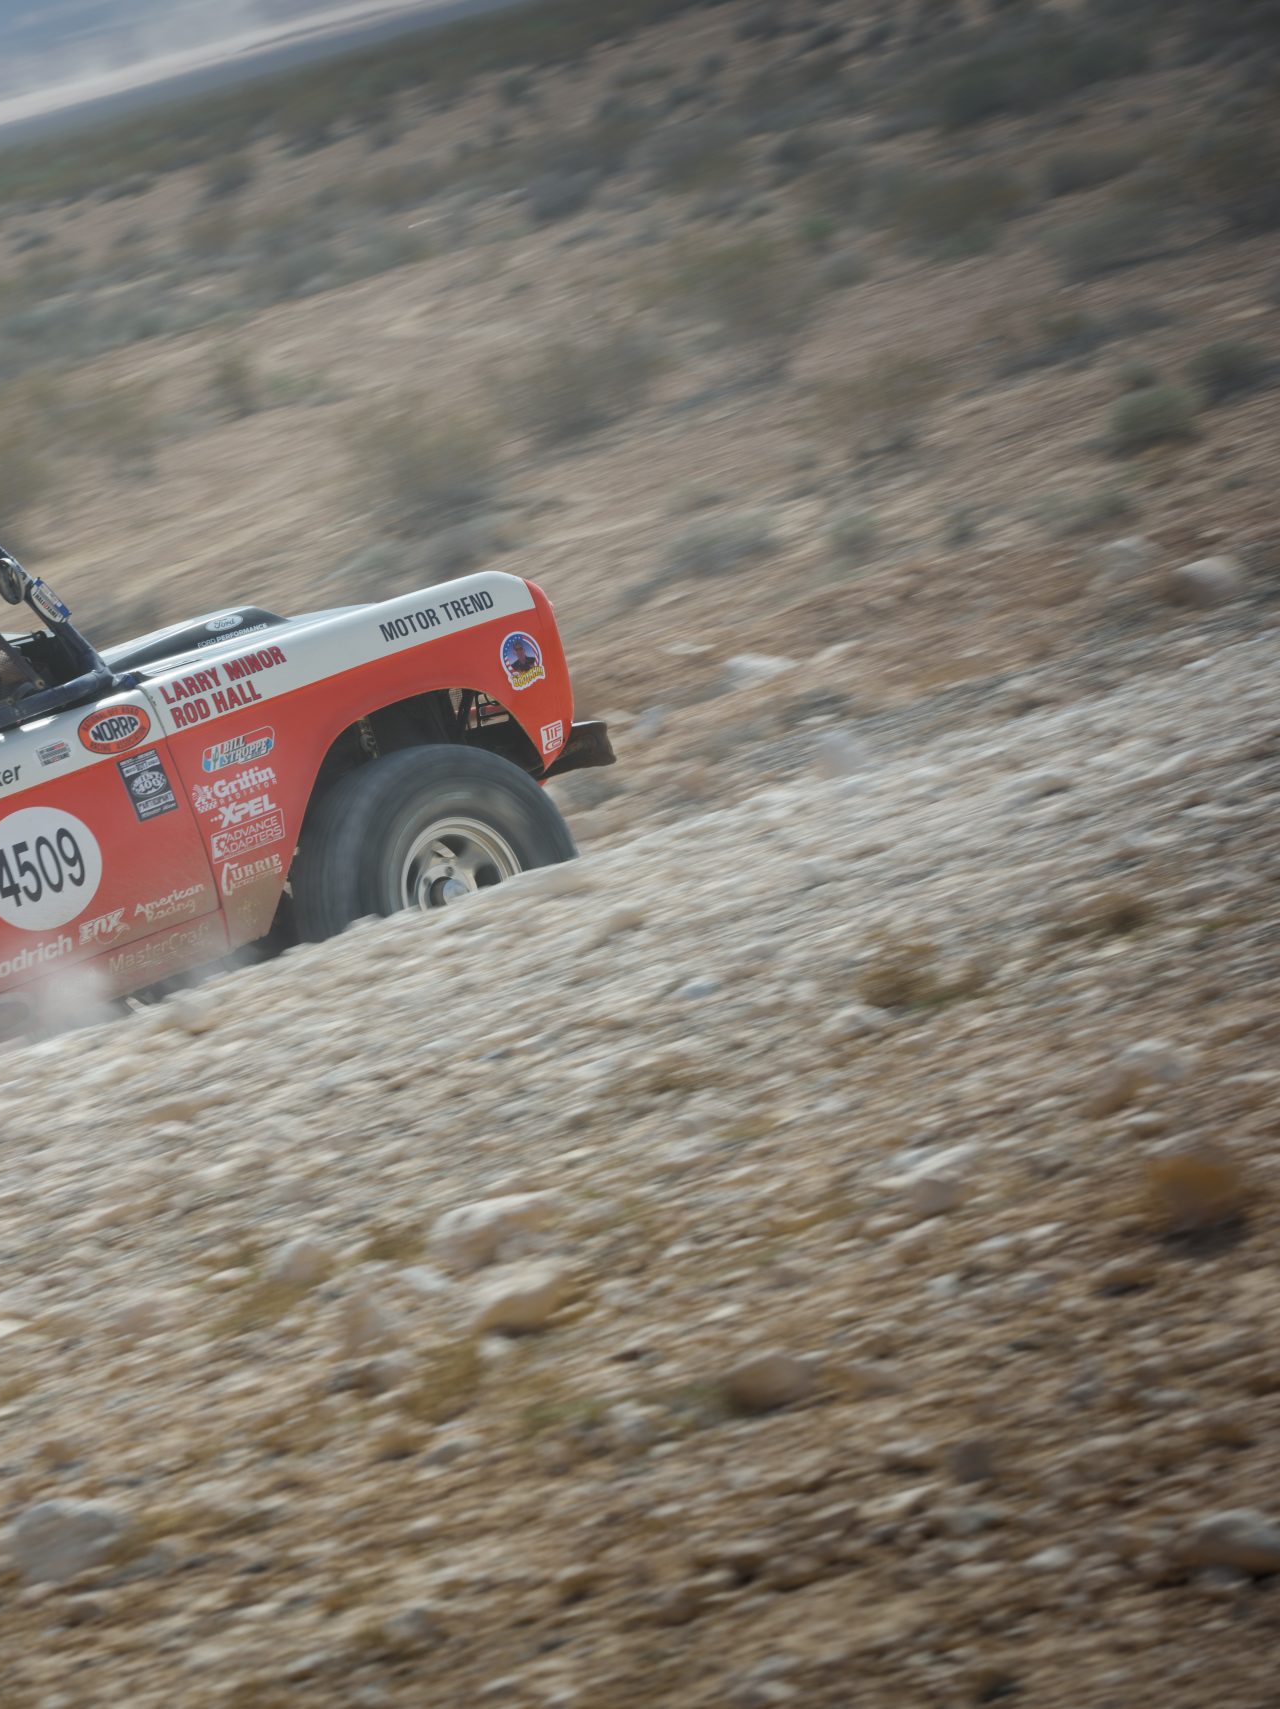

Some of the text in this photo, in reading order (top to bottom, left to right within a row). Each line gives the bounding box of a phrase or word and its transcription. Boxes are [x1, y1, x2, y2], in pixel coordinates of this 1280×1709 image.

[214, 617, 234, 629] Ford
[379, 591, 494, 642] MOTOR TREND
[198, 623, 268, 648] FORD PERFORMANCE
[159, 646, 287, 705] LARRY MINOR
[170, 680, 262, 728] ROD HALL
[91, 716, 139, 742] NORRA
[221, 738, 269, 764] STROPPE
[223, 736, 246, 754] BILL
[213, 766, 276, 798] Griffin
[218, 794, 276, 828] XPEL
[221, 825, 282, 856] ADAPTERS
[227, 816, 278, 843] ADVANCE
[221, 853, 282, 896] CURRIE
[134, 884, 204, 917] American
[146, 899, 196, 923] Racing
